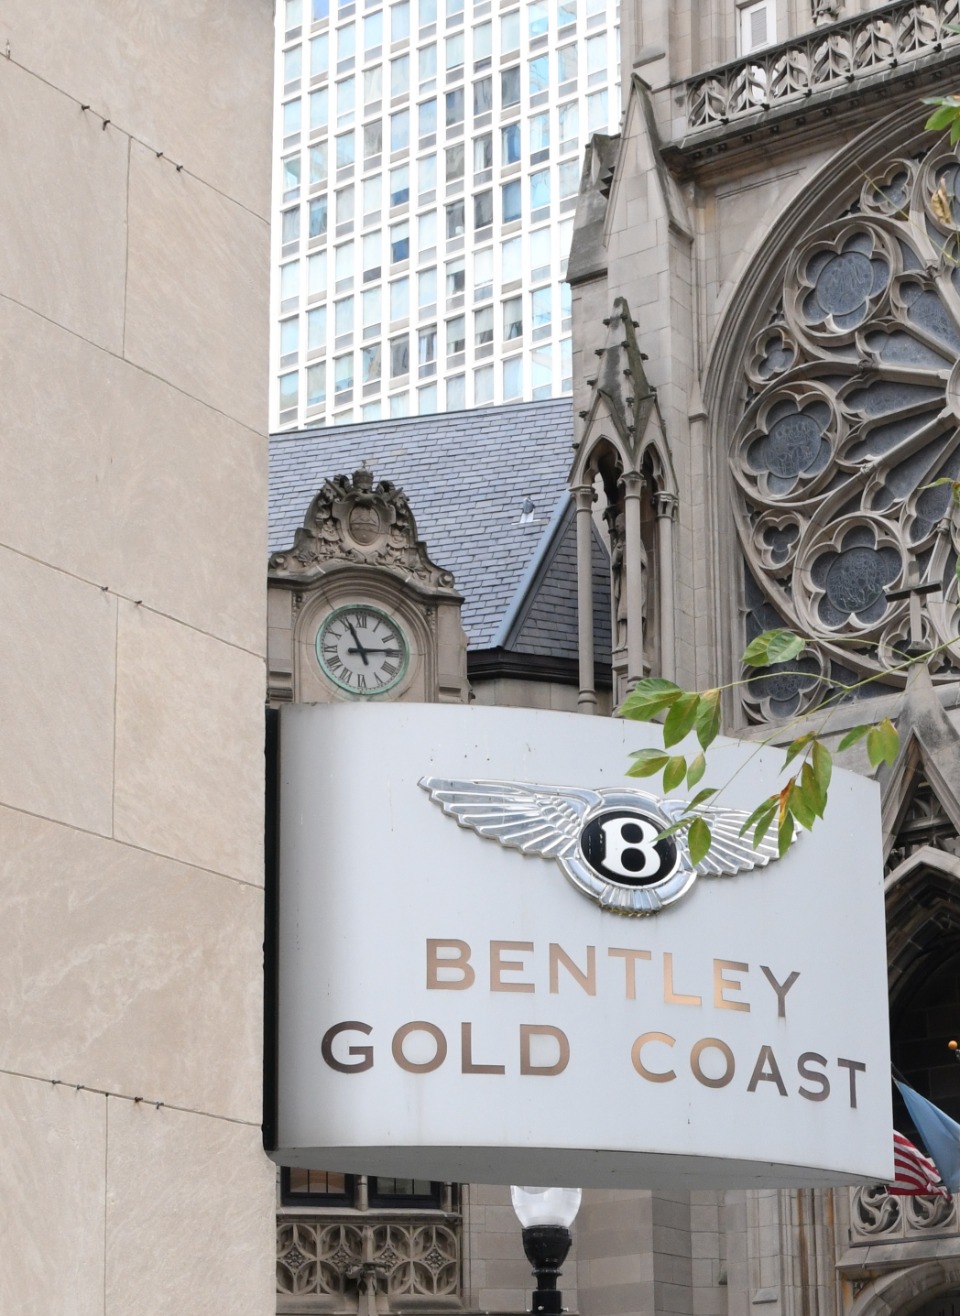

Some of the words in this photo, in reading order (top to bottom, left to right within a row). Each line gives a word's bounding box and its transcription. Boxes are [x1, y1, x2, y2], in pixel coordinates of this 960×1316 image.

[601, 817, 661, 878] B
[425, 937, 801, 1018] BENTLEY
[320, 1020, 571, 1077] GOLD
[630, 1031, 867, 1109] COAST
